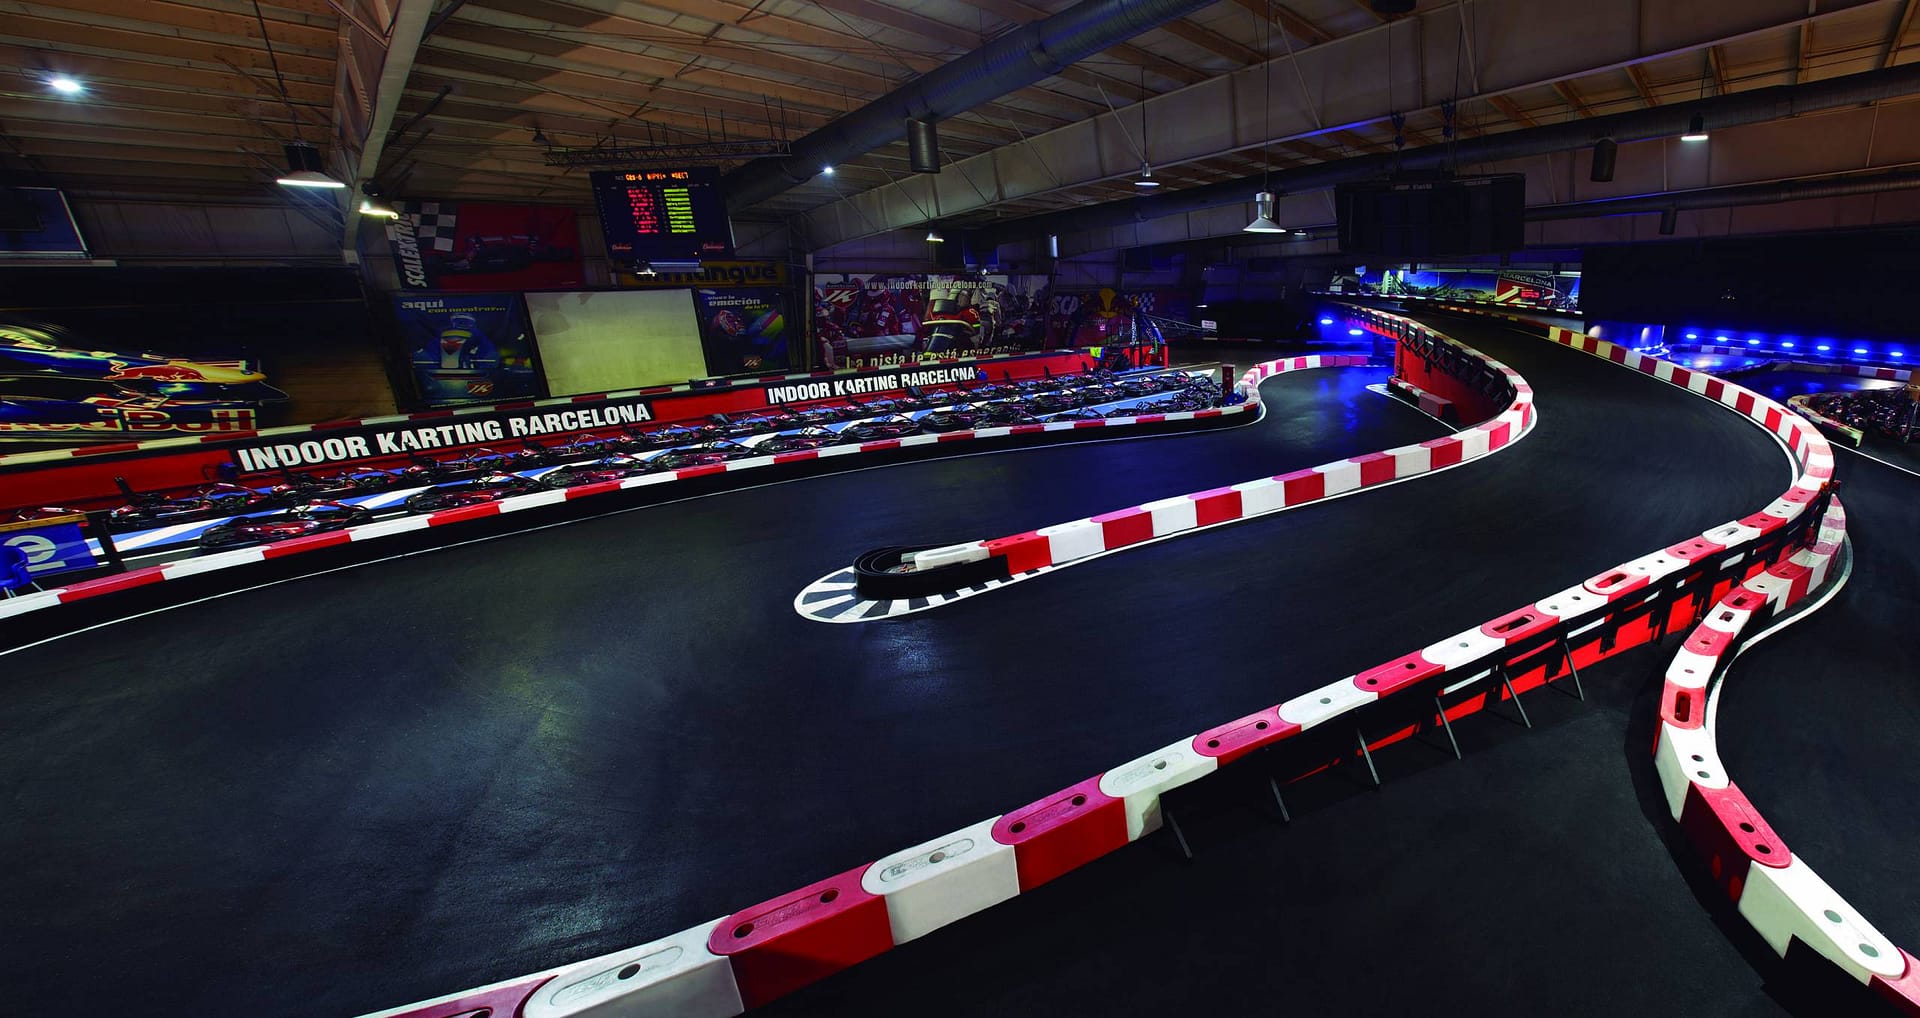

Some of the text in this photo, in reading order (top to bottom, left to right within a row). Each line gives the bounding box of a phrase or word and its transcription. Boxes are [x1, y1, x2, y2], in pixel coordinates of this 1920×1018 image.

[708, 297, 761, 307] emoción
[911, 351, 924, 363] te
[767, 366, 976, 404] INDOOR KARTING BARCELONA
[237, 403, 652, 472] INDOOR KARTING BARCELONA
